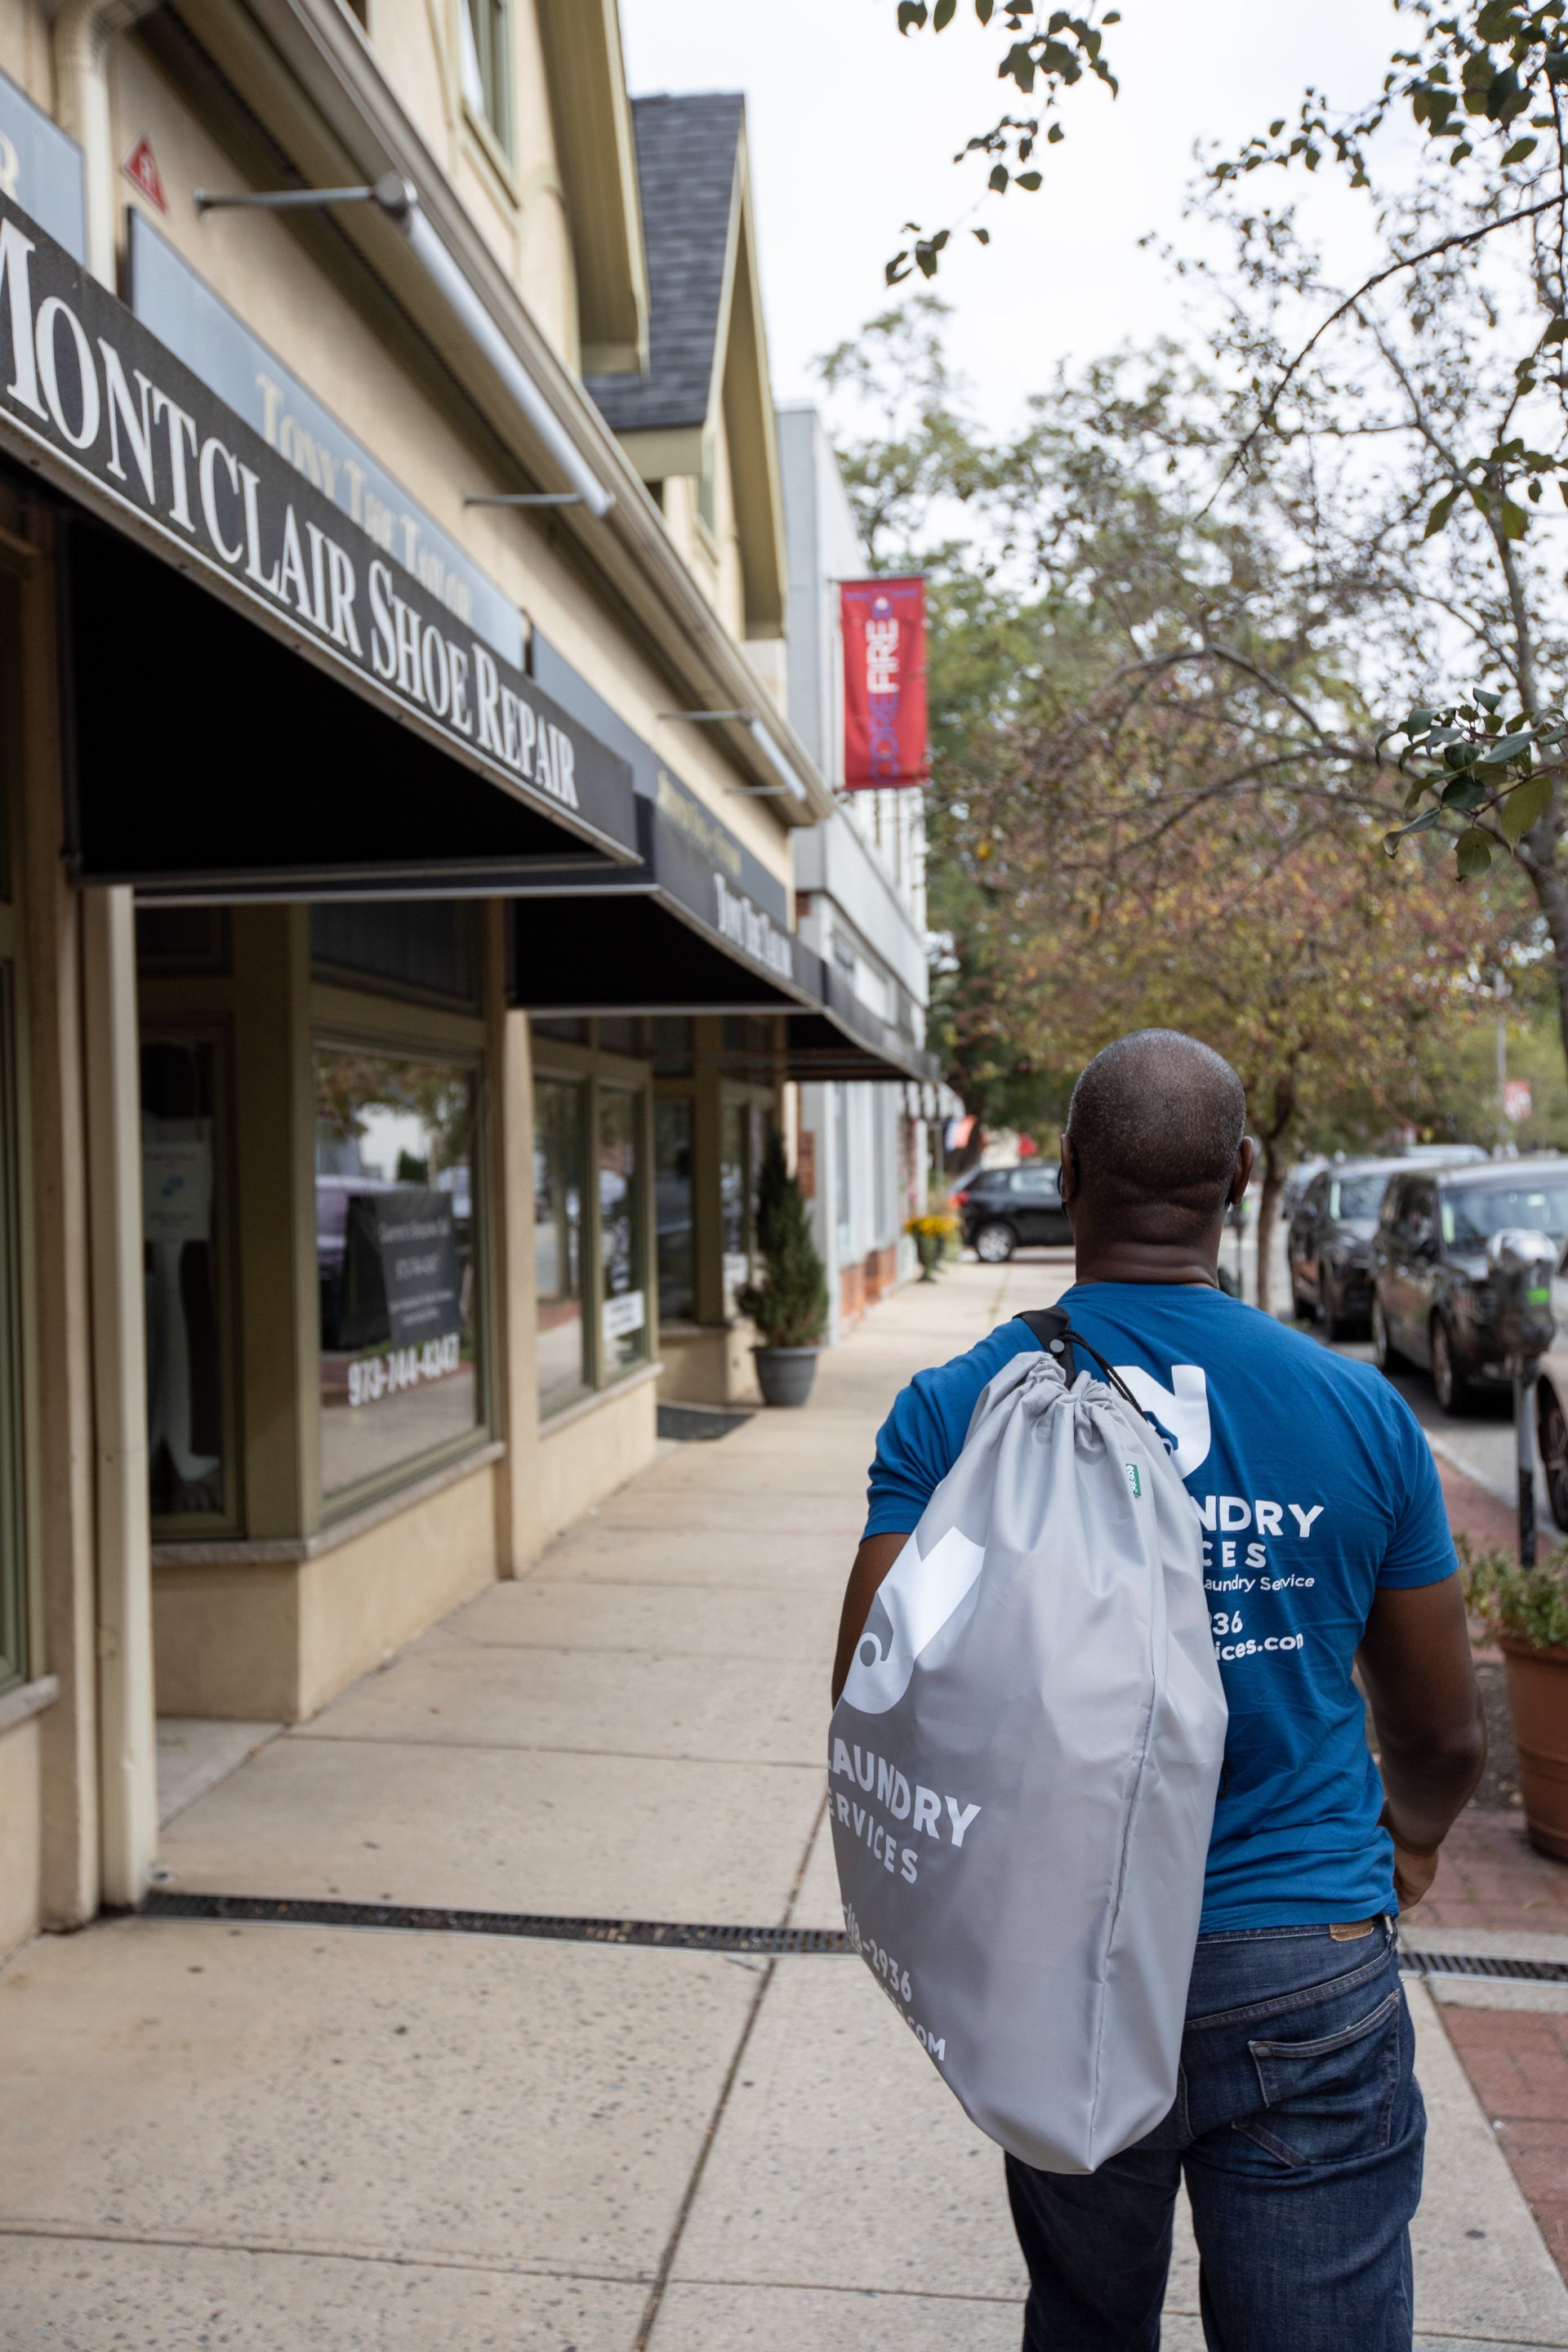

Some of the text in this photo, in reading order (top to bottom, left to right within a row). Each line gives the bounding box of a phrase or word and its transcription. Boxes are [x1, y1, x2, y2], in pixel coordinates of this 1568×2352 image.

[369, 559, 473, 736] SHOE
[471, 642, 579, 809] REPAIR
[1204, 1574, 1256, 1592] aundry
[1209, 1610, 1243, 1635] 36
[828, 1737, 982, 1848] AUNDRY
